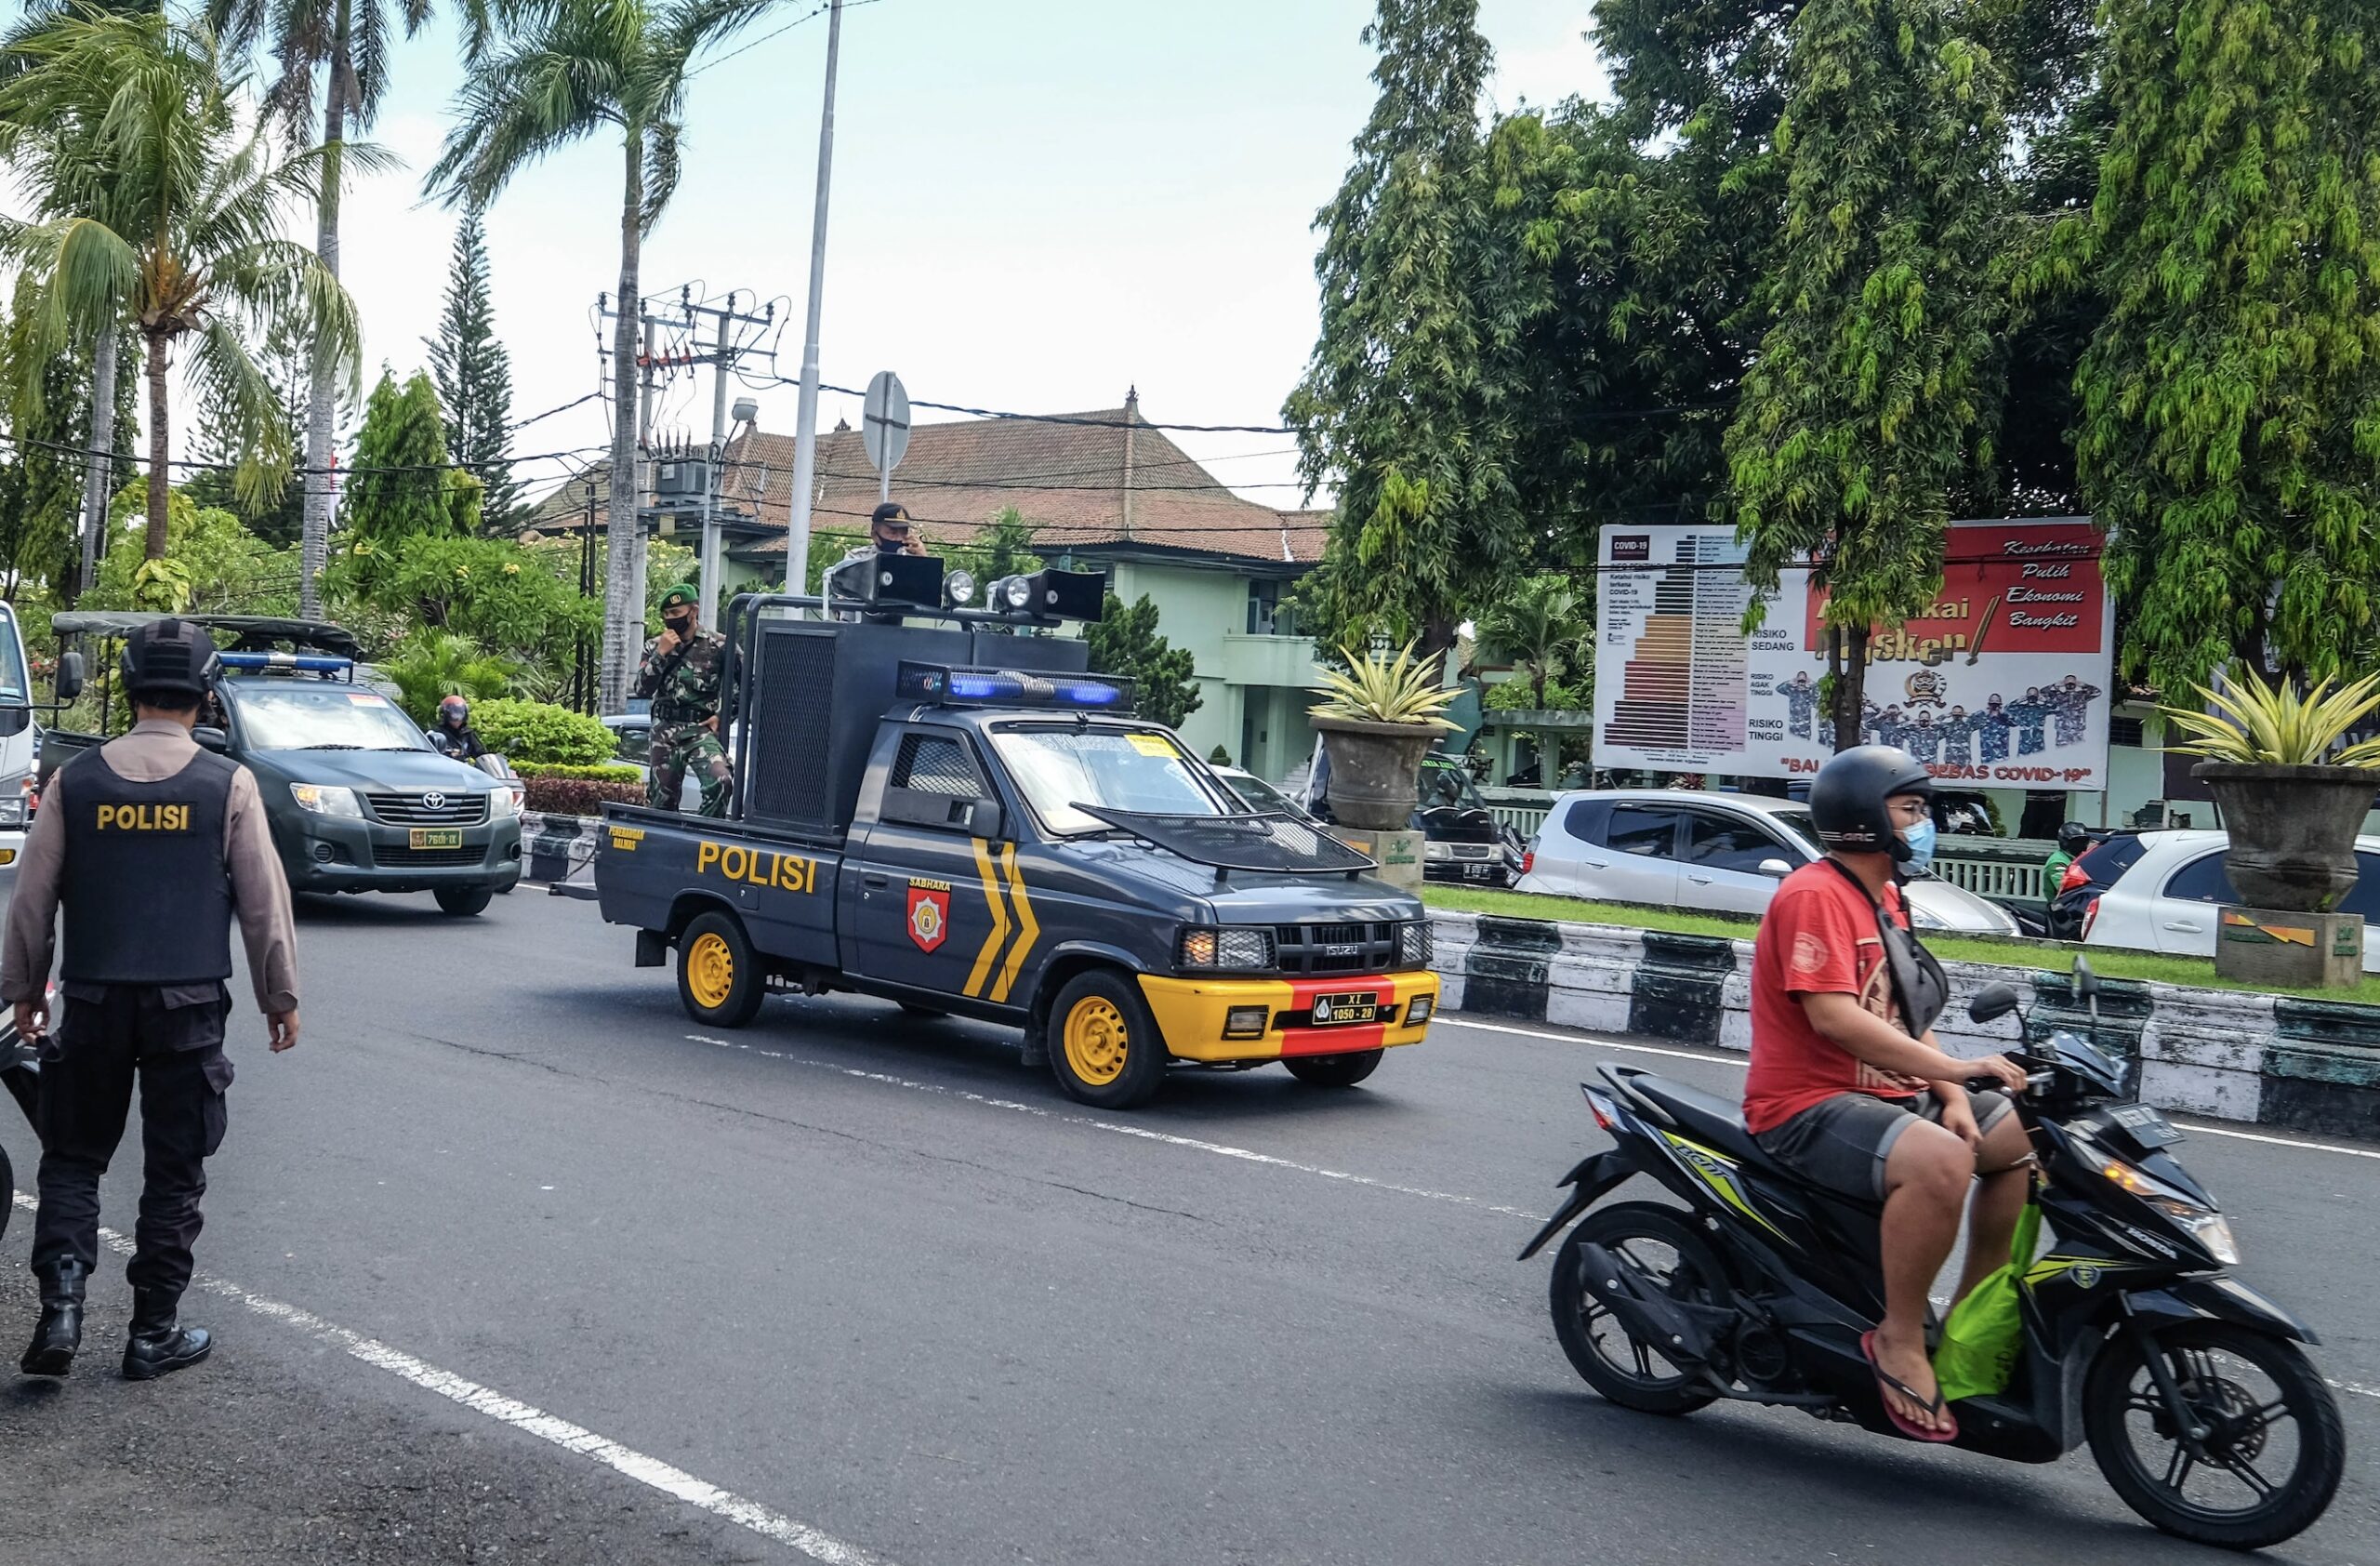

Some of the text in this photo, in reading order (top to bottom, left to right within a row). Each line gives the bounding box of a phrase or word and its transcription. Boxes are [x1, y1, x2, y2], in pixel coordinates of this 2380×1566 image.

[1614, 541, 1647, 551] COVID-19
[2003, 540, 2090, 555] Kesehatan
[2022, 563, 2070, 578] Pulih
[2006, 587, 2084, 603] Ekonomi
[2009, 611, 2078, 630] Bangkit
[1752, 630, 1787, 639] RISIKO
[1752, 642, 1794, 651] SEDANG
[1749, 719, 1783, 729] RISIKO
[1749, 731, 1783, 741] TINGGI
[97, 804, 189, 830] POLISI
[697, 841, 817, 894] POLISI
[909, 877, 951, 892] SABHARA
[1326, 945, 1358, 956] ISUZU
[1348, 994, 1362, 1004] XI
